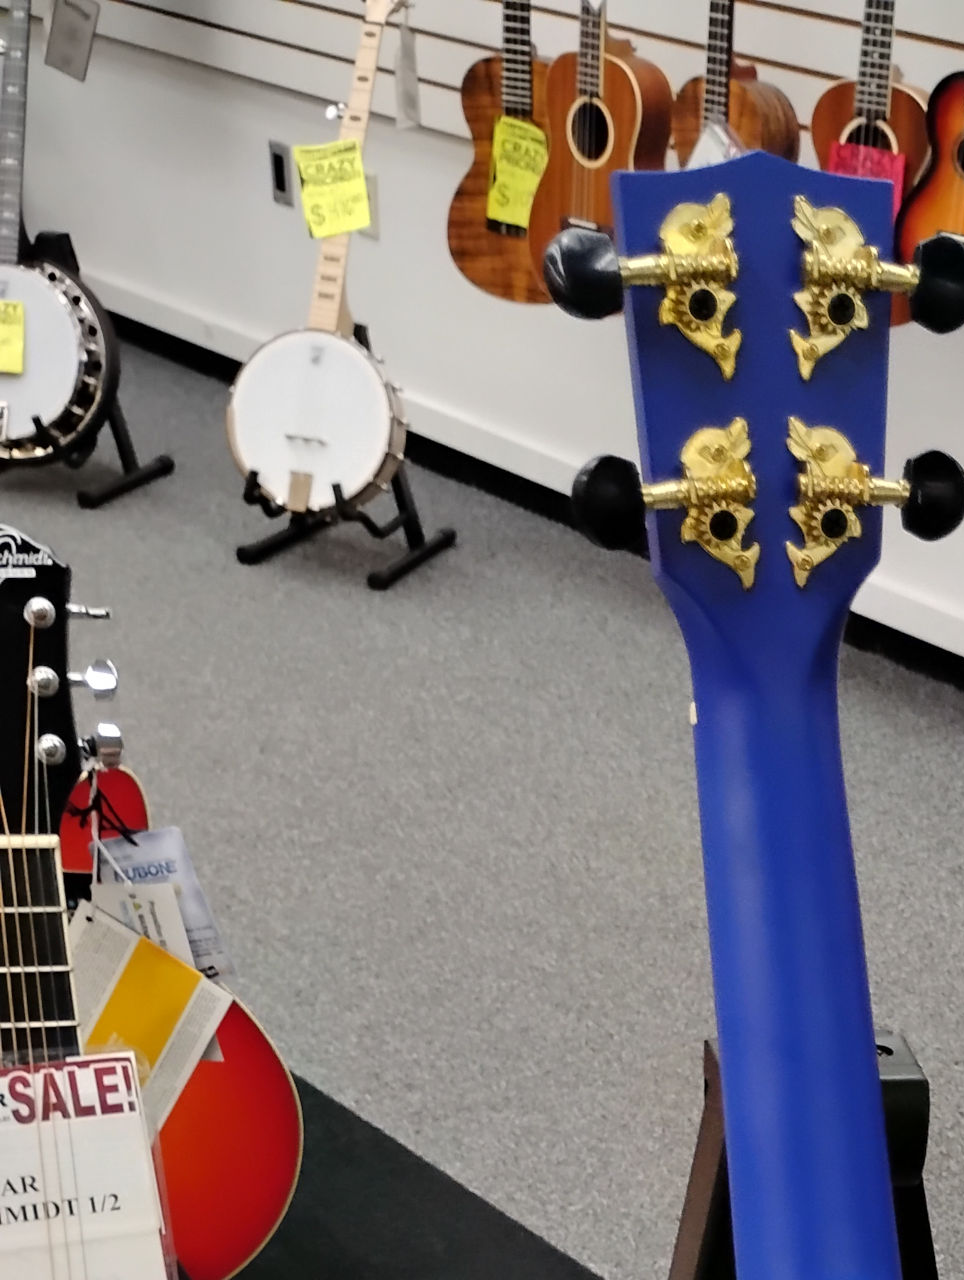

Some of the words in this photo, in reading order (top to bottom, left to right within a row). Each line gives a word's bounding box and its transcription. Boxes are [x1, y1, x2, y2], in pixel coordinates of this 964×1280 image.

[8, 1064, 136, 1124] SALE!
[0, 1197, 79, 1226] MIDT
[89, 1193, 121, 1213] 1/2
